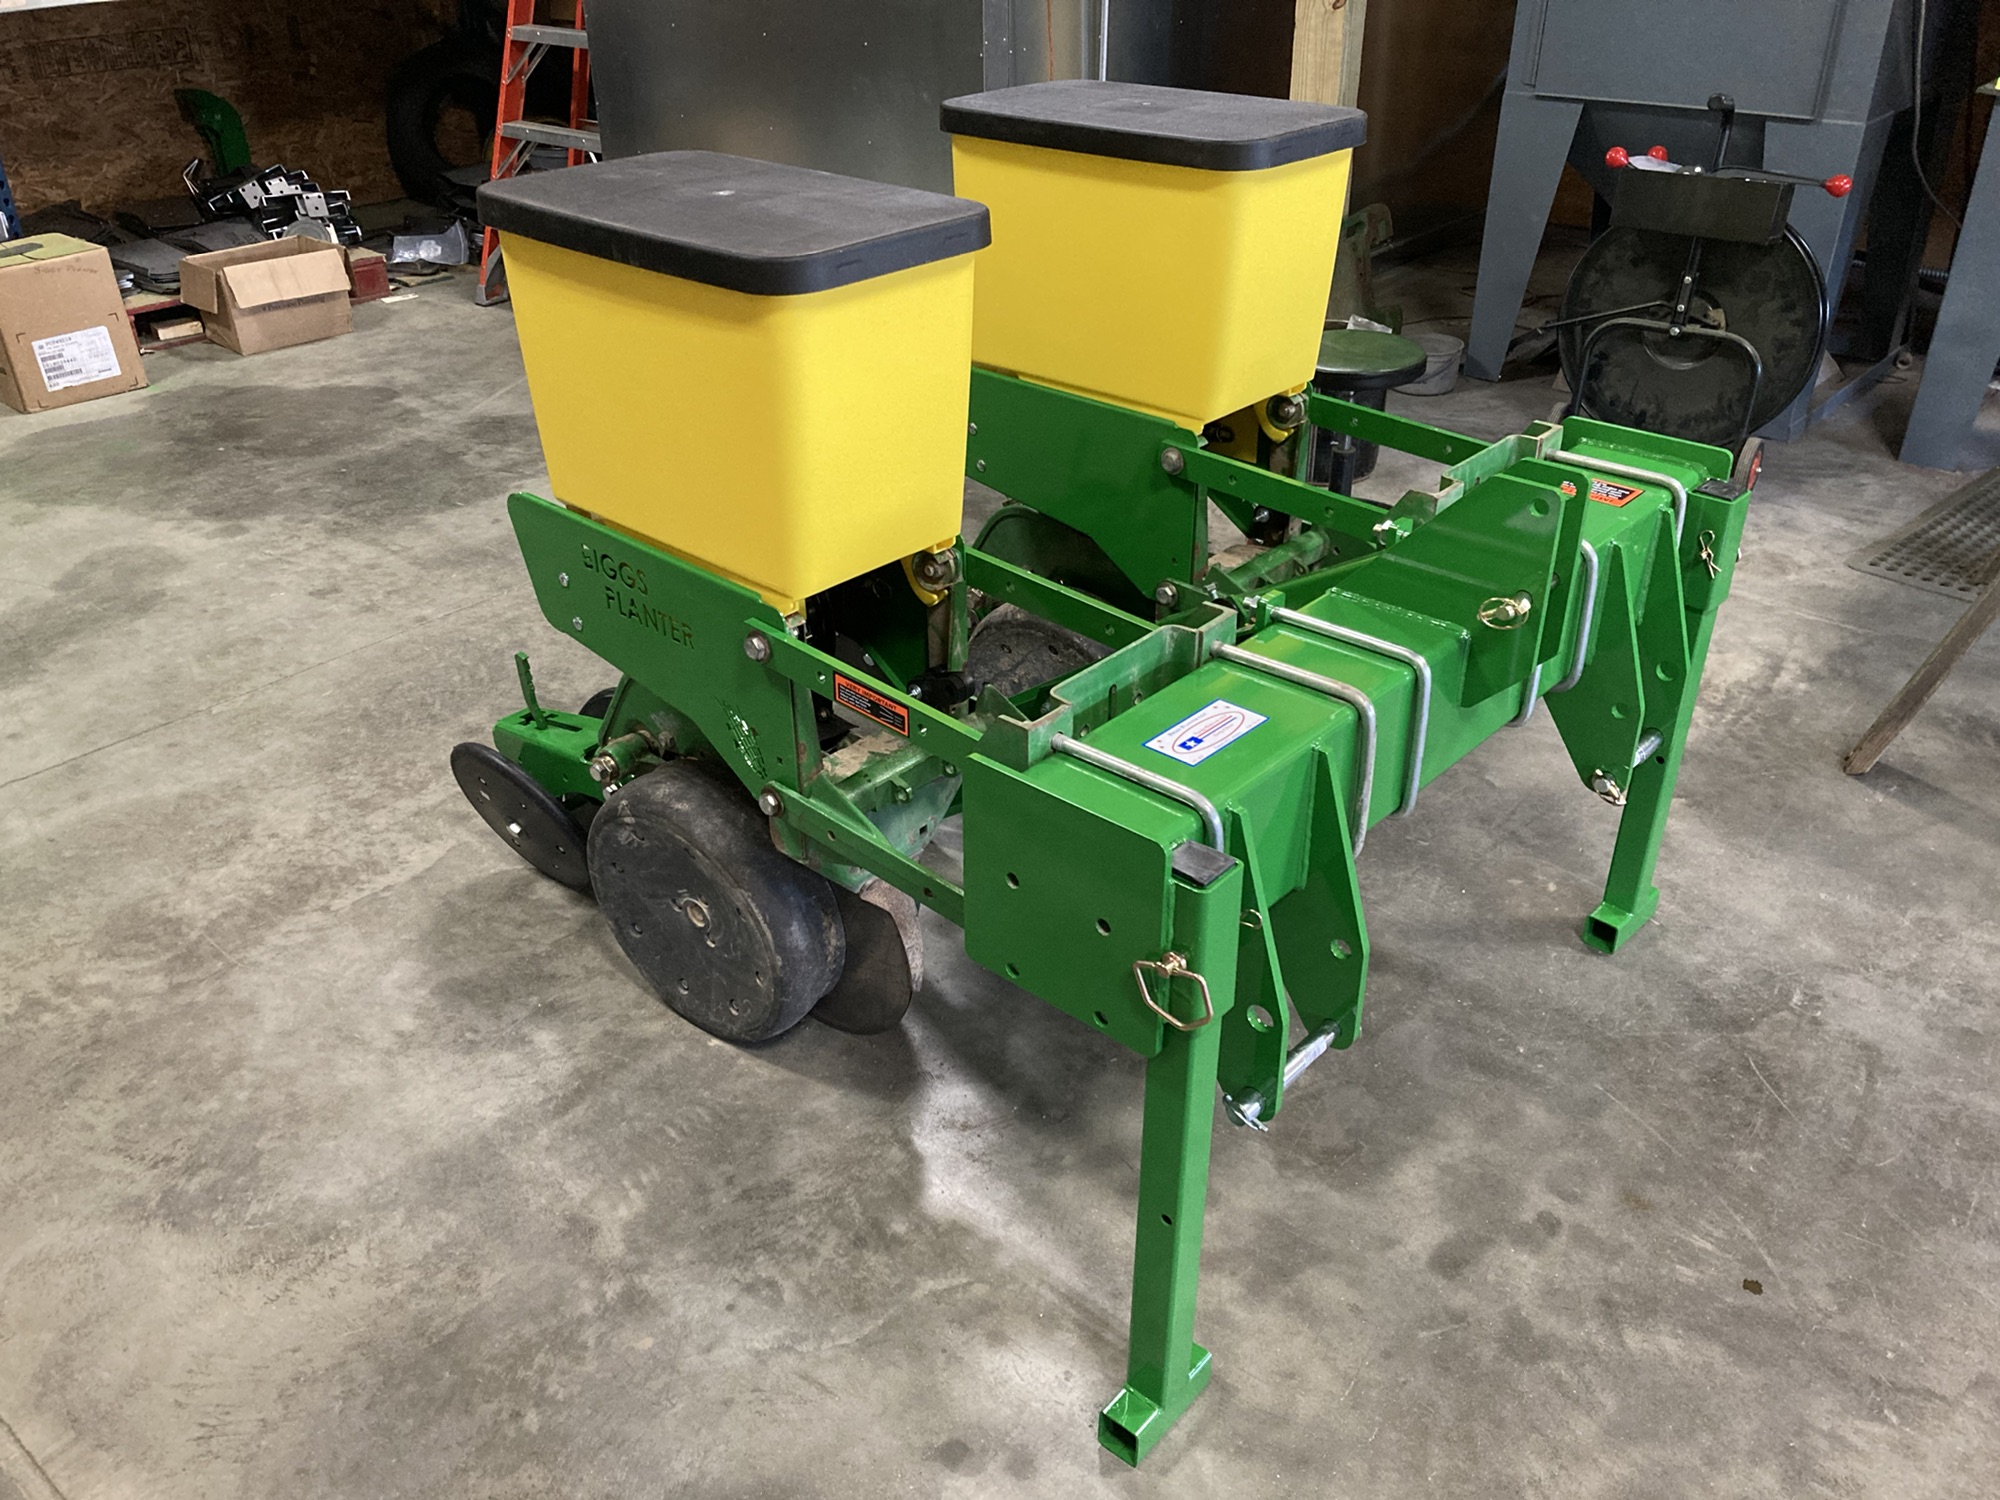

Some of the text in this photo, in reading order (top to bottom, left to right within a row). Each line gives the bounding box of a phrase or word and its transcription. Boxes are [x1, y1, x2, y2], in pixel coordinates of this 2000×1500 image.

[604, 585, 695, 650] PLANTER
[845, 682, 860, 692] VERY
[862, 691, 897, 711] IMPORTANT
